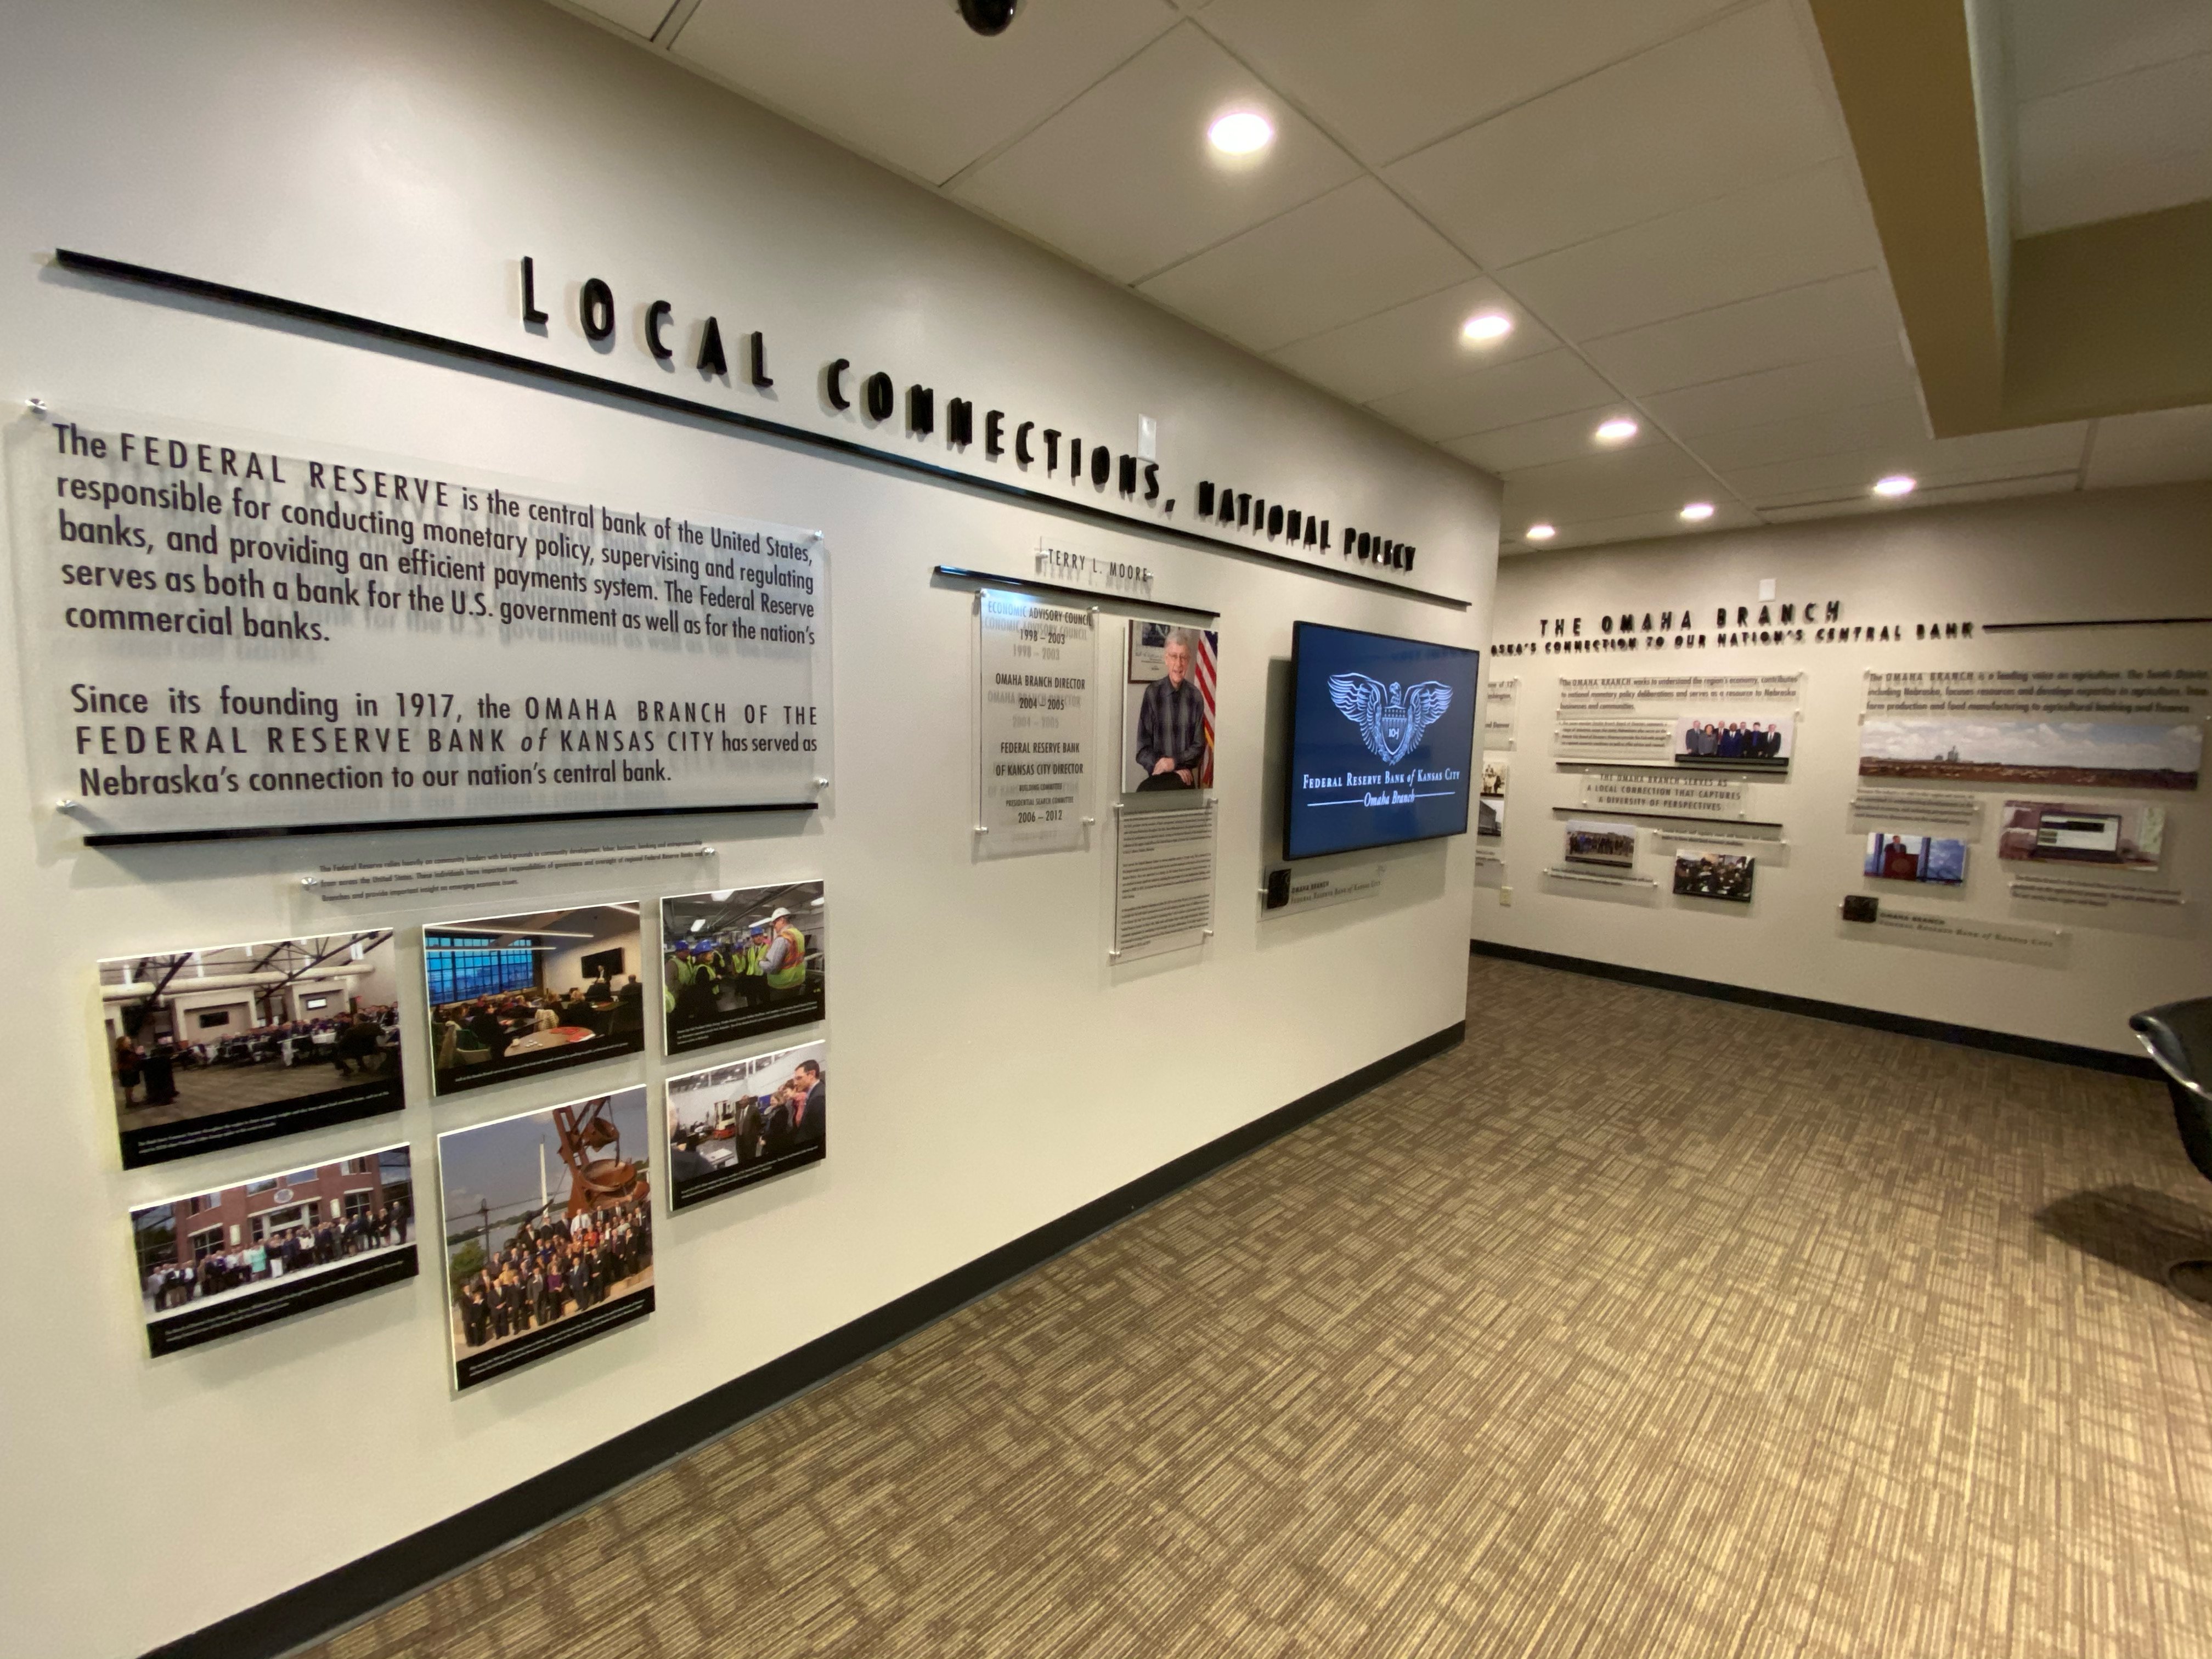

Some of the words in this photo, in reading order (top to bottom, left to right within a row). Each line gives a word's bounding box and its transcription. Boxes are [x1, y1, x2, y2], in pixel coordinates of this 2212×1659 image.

[521, 256, 773, 388] LOCAL
[827, 358, 1176, 513] CONNECTIONS,
[1198, 481, 1331, 549] NATIONAL
[1344, 527, 1417, 571] POLICY
[53, 423, 107, 458] The
[121, 433, 285, 483] FEDERAL
[309, 462, 448, 506] RESERVE
[462, 487, 478, 511] is
[487, 490, 520, 517] the
[528, 501, 594, 529] central
[602, 506, 647, 537] bank
[654, 517, 672, 539] of
[678, 521, 703, 545] the
[711, 526, 760, 555] United
[766, 537, 812, 566] States,
[58, 476, 222, 515] responsible
[233, 488, 271, 521] for
[281, 500, 414, 545] conducting
[423, 523, 528, 558] monetary
[535, 537, 595, 566] policy,
[601, 547, 700, 580] supervising
[705, 560, 735, 580] and
[740, 566, 814, 595] regulating
[59, 509, 154, 555] banks,
[167, 524, 217, 555] and
[230, 535, 349, 574] providing
[359, 550, 388, 572] an
[398, 549, 486, 582] efficient
[494, 566, 587, 592] payments
[594, 577, 658, 603] system.
[664, 580, 693, 604] The
[699, 584, 755, 611] Federal
[761, 593, 814, 618] Reserve
[1048, 549, 1085, 571] TERRY
[1093, 558, 1102, 574] L.
[1109, 562, 1148, 582] MOORE
[63, 563, 157, 590] serves
[166, 572, 196, 592] as
[203, 564, 264, 600] both
[274, 580, 288, 600] a
[296, 573, 360, 606] bank
[368, 580, 401, 610] for
[409, 584, 444, 613] the
[452, 591, 493, 617] U.S.
[500, 601, 617, 628] government
[622, 612, 641, 630] as
[645, 609, 679, 633] well
[683, 619, 701, 635] as
[706, 614, 728, 638] for
[732, 617, 757, 640] the
[988, 601, 1027, 618] ECONOMIC
[1029, 607, 1062, 623] ADVISORY
[1064, 612, 1092, 627] COUNCIL
[66, 606, 233, 636] commercial
[242, 607, 330, 641] banks.
[1540, 618, 1581, 636] THE
[1601, 610, 1691, 634] OMAHA
[1717, 601, 1839, 628] BRANCH
[1020, 629, 1038, 641] 1998
[1048, 632, 1065, 645] 2003
[1545, 637, 1637, 654] CONNECTION
[1647, 636, 1664, 647] TO
[1675, 635, 1706, 648] OUR
[1816, 625, 1901, 641] CENTRAL
[1917, 622, 1973, 639] BANK
[995, 673, 1022, 686] OMAHA
[1025, 675, 1053, 689] BRANCH
[1054, 678, 1085, 690] DIRECTOR
[71, 684, 148, 714] Since
[168, 687, 201, 714] its
[219, 685, 339, 723] founding
[356, 692, 379, 717] in
[396, 692, 463, 723] 1917,
[477, 693, 510, 720] the
[525, 697, 617, 721] OMAHA
[638, 700, 726, 723] BRANCH
[744, 704, 768, 725] OF
[783, 706, 817, 726] THE
[1019, 697, 1037, 709] 2004
[1047, 699, 1064, 710] 2005
[76, 726, 247, 754] FEDERAL
[267, 727, 411, 753] RESERVE
[428, 729, 504, 752] BANK
[520, 729, 548, 752] of
[561, 730, 654, 752] KANSAS
[667, 731, 714, 752] CITY
[722, 732, 748, 752] has
[752, 732, 799, 752] served
[802, 737, 817, 752] as
[1001, 742, 1031, 754] FEDERAL
[1033, 742, 1060, 753] RESERVE
[1063, 742, 1080, 753] BANK
[250, 766, 383, 792] connection
[392, 767, 414, 788] to
[423, 770, 458, 788] our
[554, 760, 616, 784] central
[623, 760, 672, 783] bank.
[996, 765, 1006, 776] OF
[1007, 764, 1035, 776] KANSAS
[1036, 764, 1052, 775] CITY
[1053, 764, 1084, 775] DIRECTOR
[1303, 774, 1342, 789] FEDERAL
[1347, 772, 1381, 786] RESERVE
[1385, 771, 1405, 784] BANK
[1407, 769, 1417, 784] of
[1417, 770, 1442, 782] KANSAS
[1445, 768, 1460, 780] CITY
[1006, 799, 1034, 807] PRESIDENTIAL
[1364, 791, 1389, 807] Omaha
[1392, 789, 1415, 804] Branch
[1018, 812, 1036, 823] 2006
[1046, 810, 1063, 821] 2012
